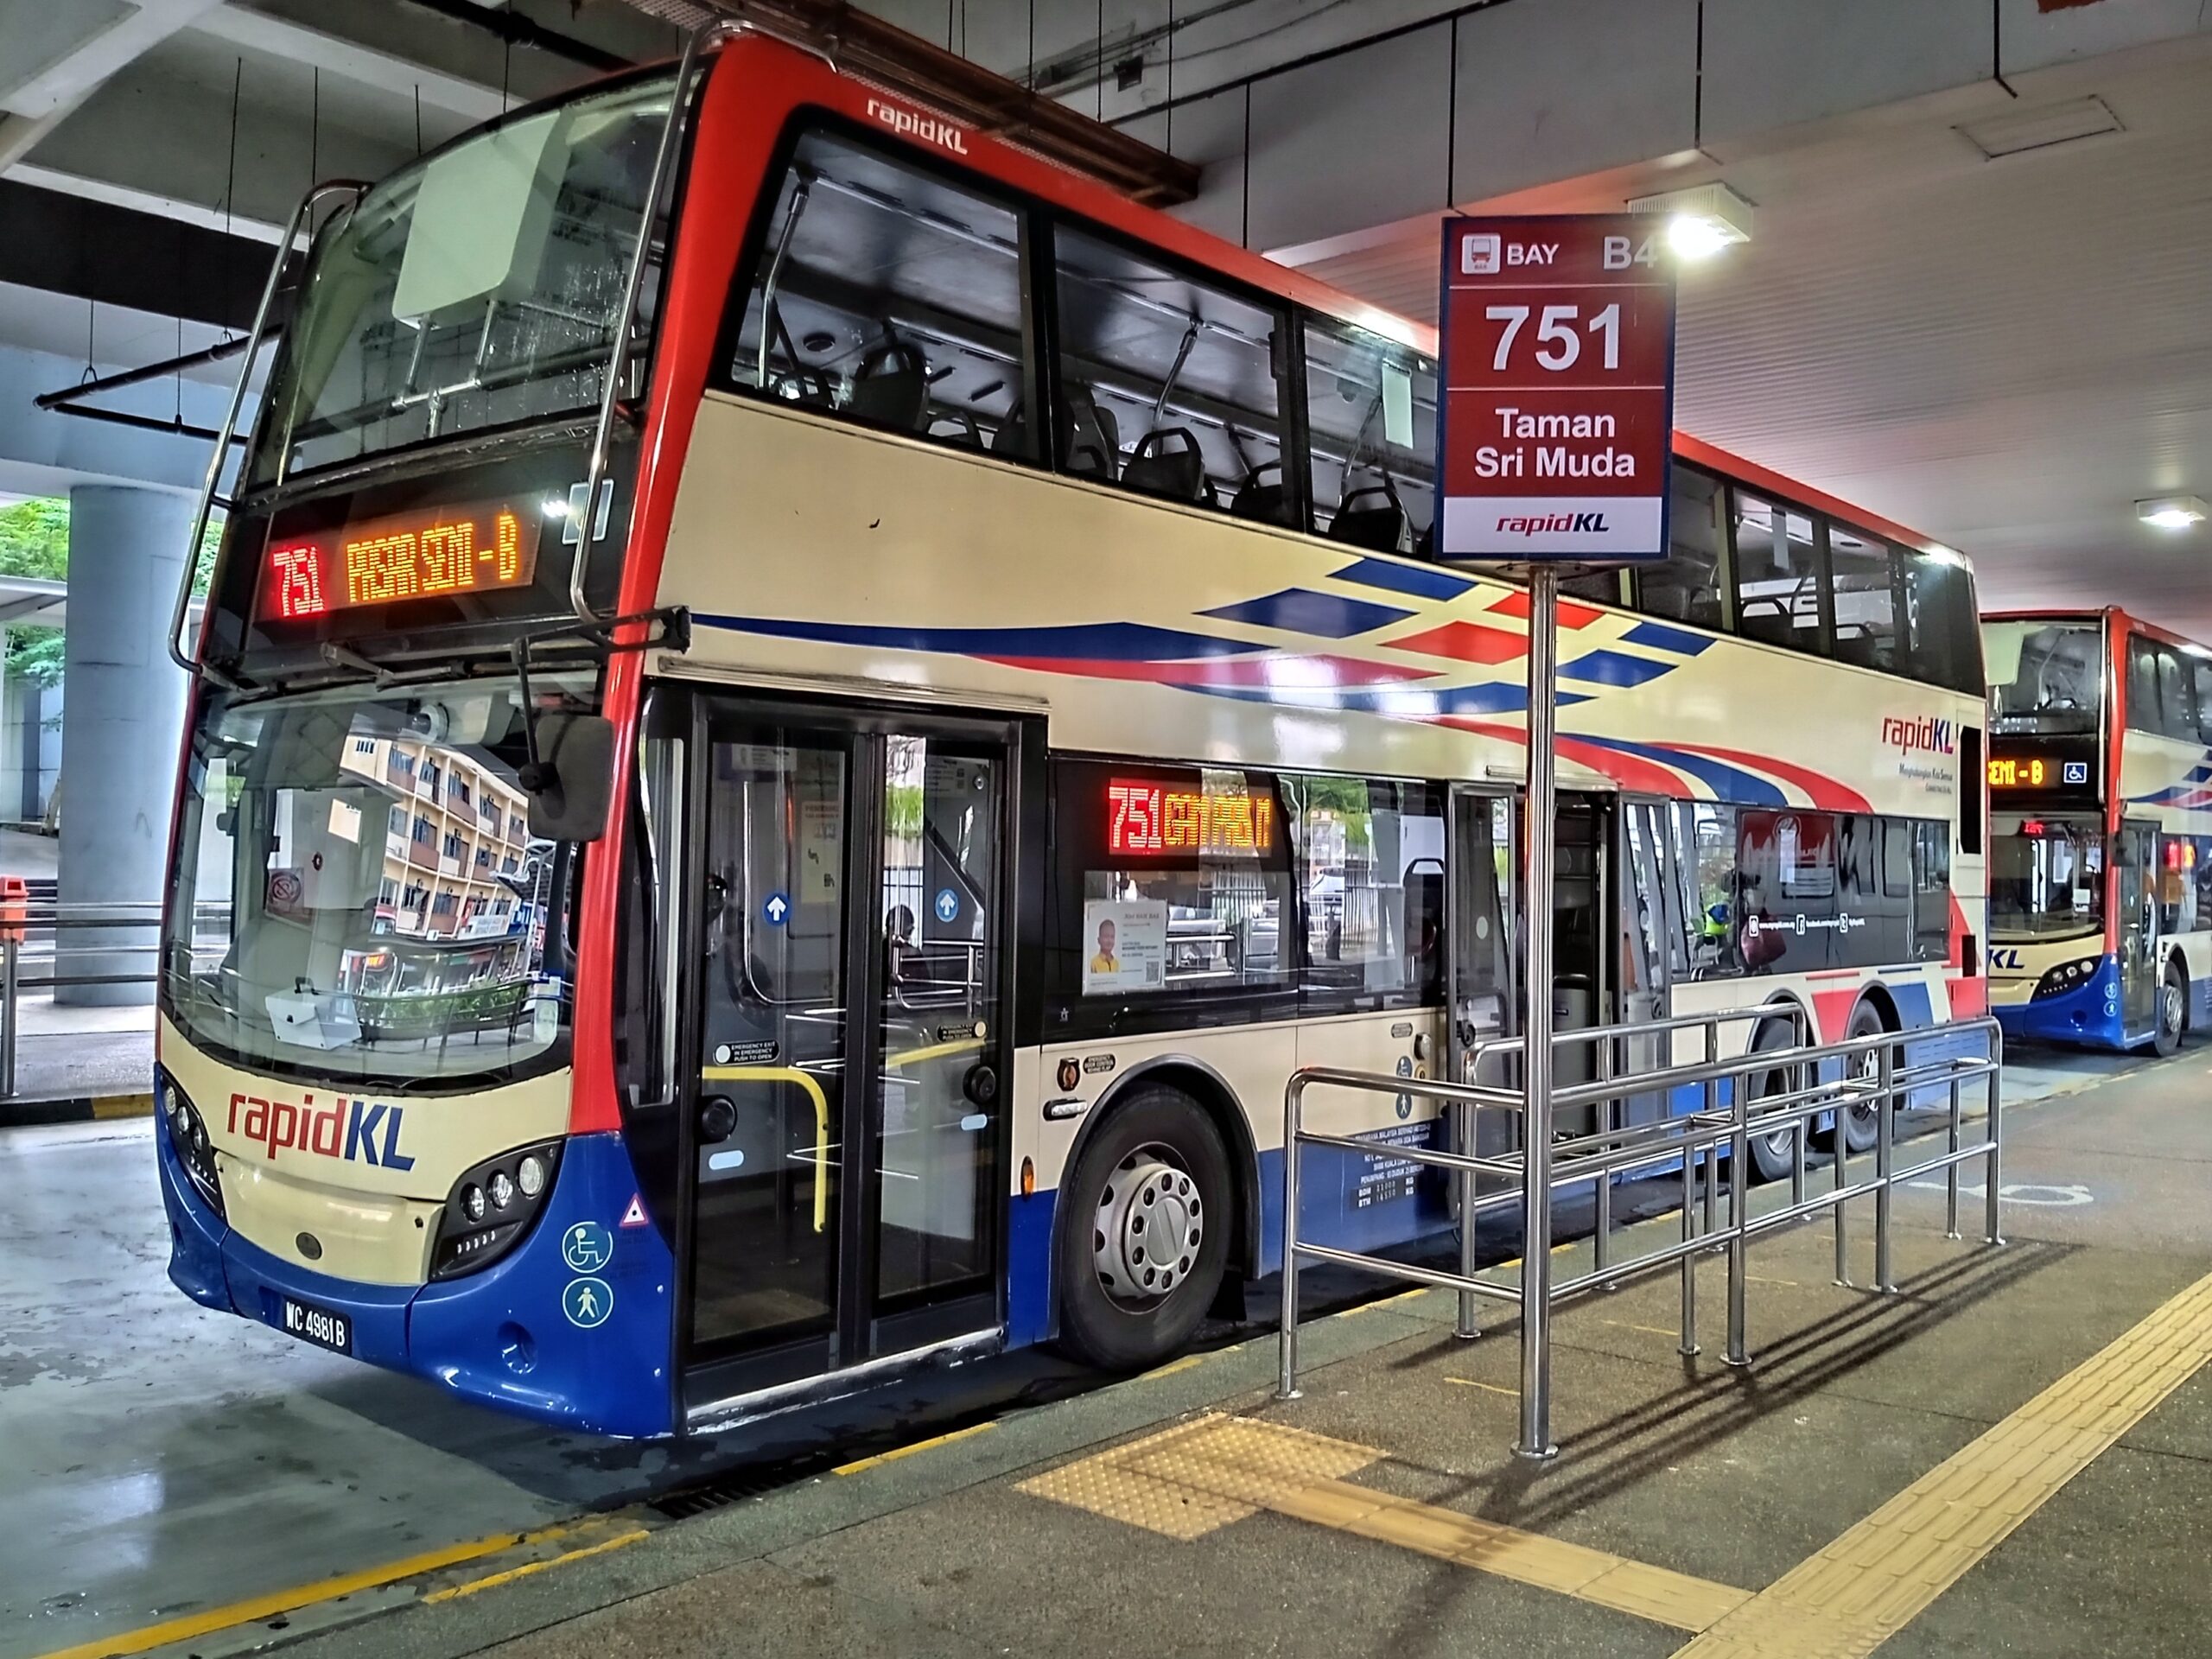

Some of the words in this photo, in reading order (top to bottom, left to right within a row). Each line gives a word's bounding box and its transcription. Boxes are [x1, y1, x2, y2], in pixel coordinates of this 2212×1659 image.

[867, 98, 969, 156] rapidKL
[1507, 243, 1560, 265] BAY
[1604, 235, 1658, 270] B4
[1485, 303, 1620, 371] 751
[1495, 408, 1615, 438] Taman
[1475, 447, 1523, 478] Sri
[1536, 447, 1636, 477] Muda
[1496, 513, 1610, 537] rapidKL
[273, 546, 325, 617] 751
[347, 533, 418, 603] PASAR
[422, 522, 474, 591] SENI
[499, 515, 517, 580] B
[1882, 715, 1954, 756] rapidKL
[2031, 760, 2044, 785] B
[1109, 786, 1162, 849] 751
[227, 1092, 416, 1173] rapidKL
[1405, 1176, 1414, 1185] KG
[1405, 1186, 1414, 1196] KG
[286, 1301, 303, 1332] WC
[305, 1310, 334, 1344] 4981
[335, 1319, 346, 1347] B
